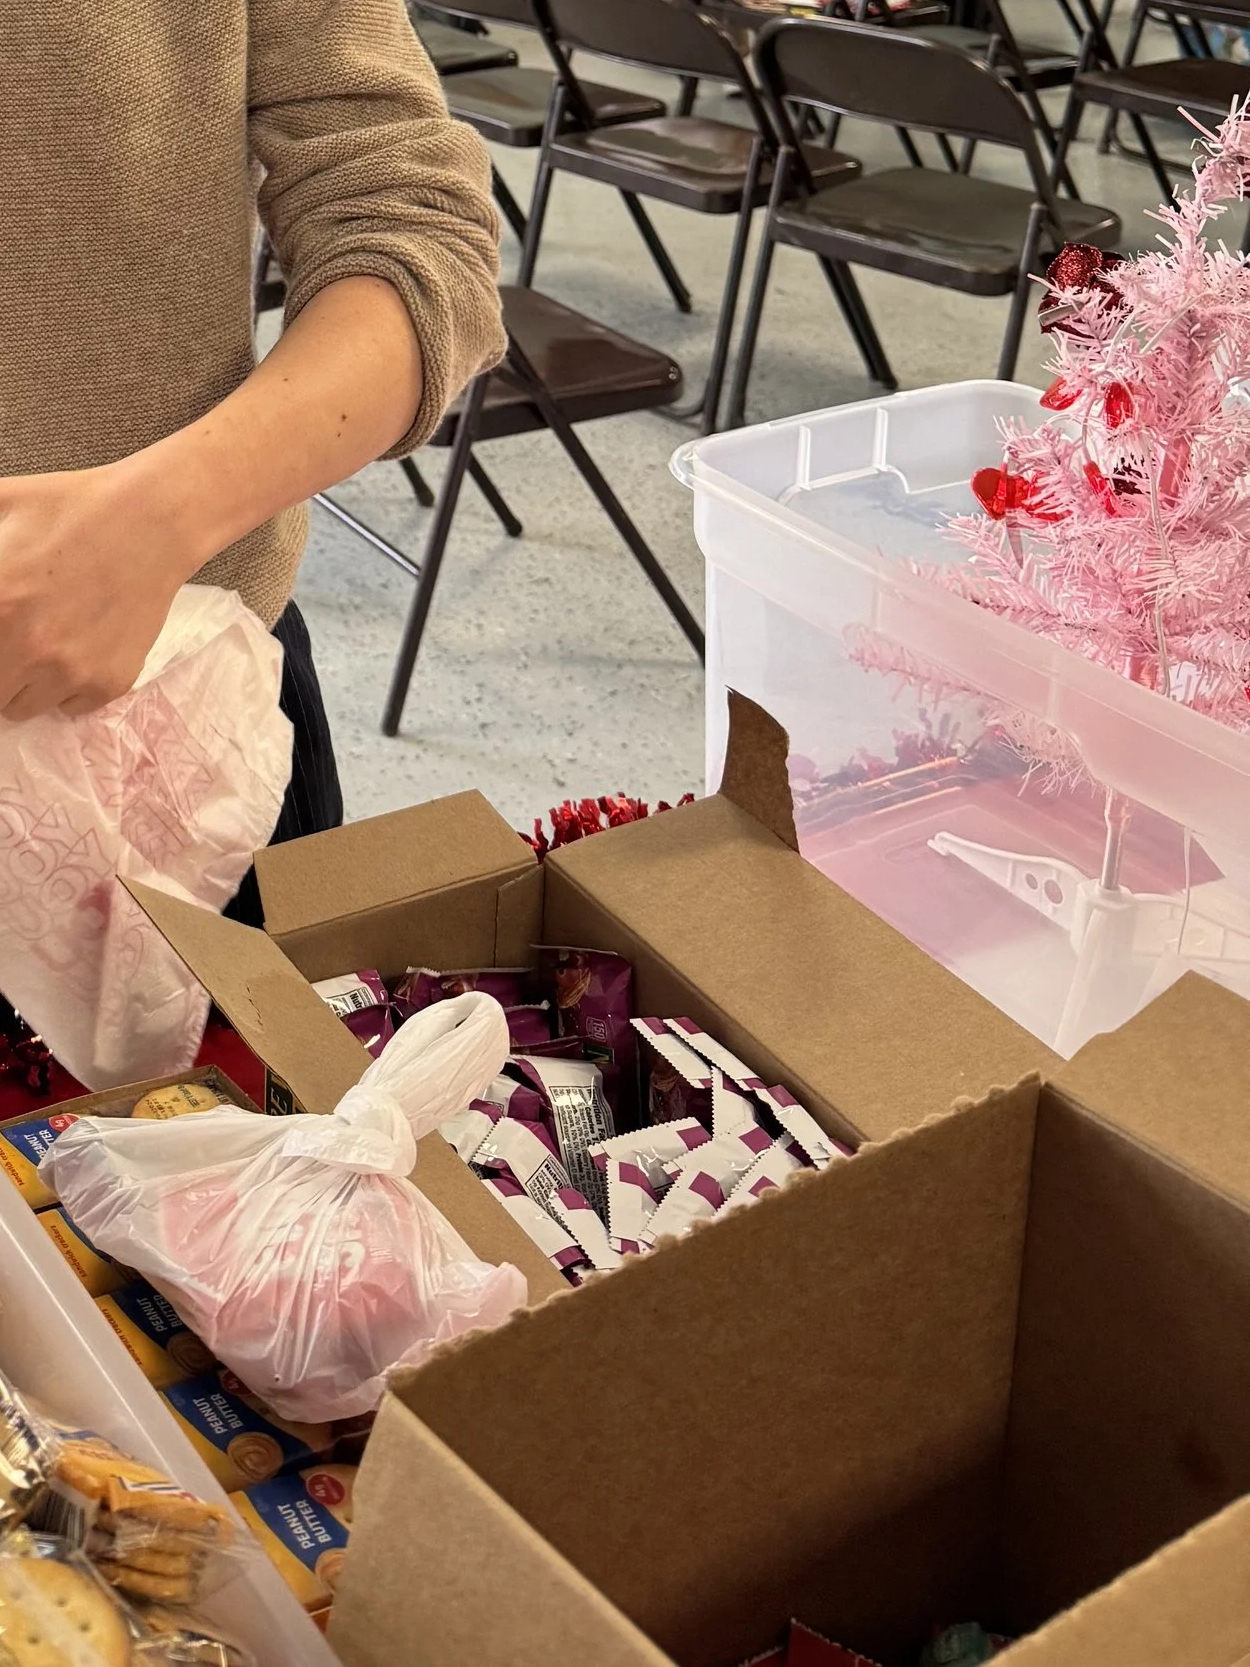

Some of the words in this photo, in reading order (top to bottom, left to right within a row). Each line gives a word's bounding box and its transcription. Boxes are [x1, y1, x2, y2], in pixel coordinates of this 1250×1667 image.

[64, 1246, 88, 1279] sandwich
[136, 1297, 168, 1333] PEANUT
[153, 1294, 183, 1328] BUTTER
[192, 1397, 228, 1435] PEANUT
[210, 1392, 244, 1429] BUTTER
[277, 1503, 316, 1550] PEANUT
[295, 1498, 333, 1544] BUTTER
